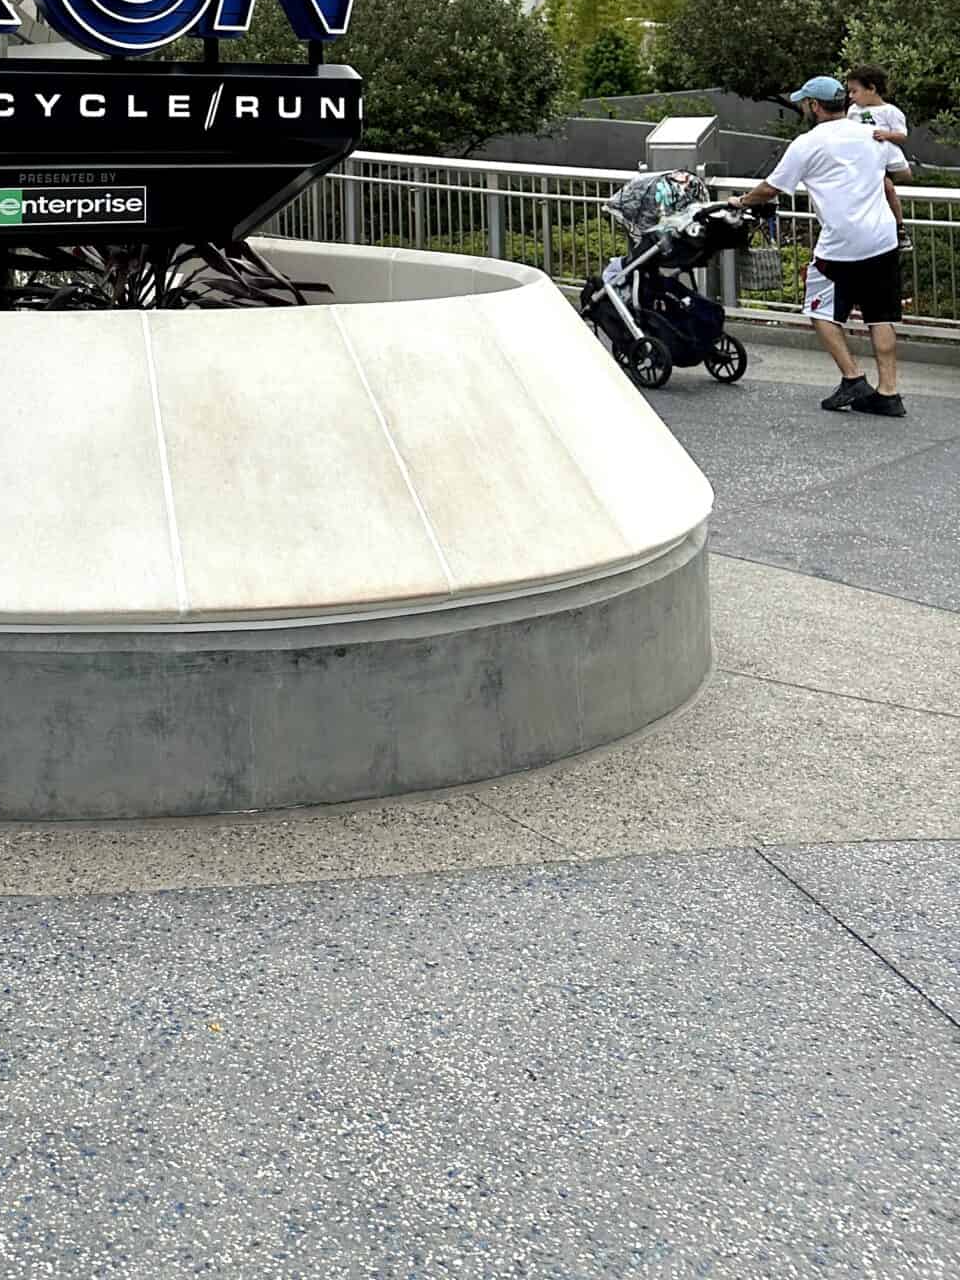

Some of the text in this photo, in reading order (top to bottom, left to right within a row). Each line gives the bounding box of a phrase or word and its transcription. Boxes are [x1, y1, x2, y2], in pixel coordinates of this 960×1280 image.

[19, 172, 117, 184] PRESENTED BY
[0, 193, 143, 219] enterprise
